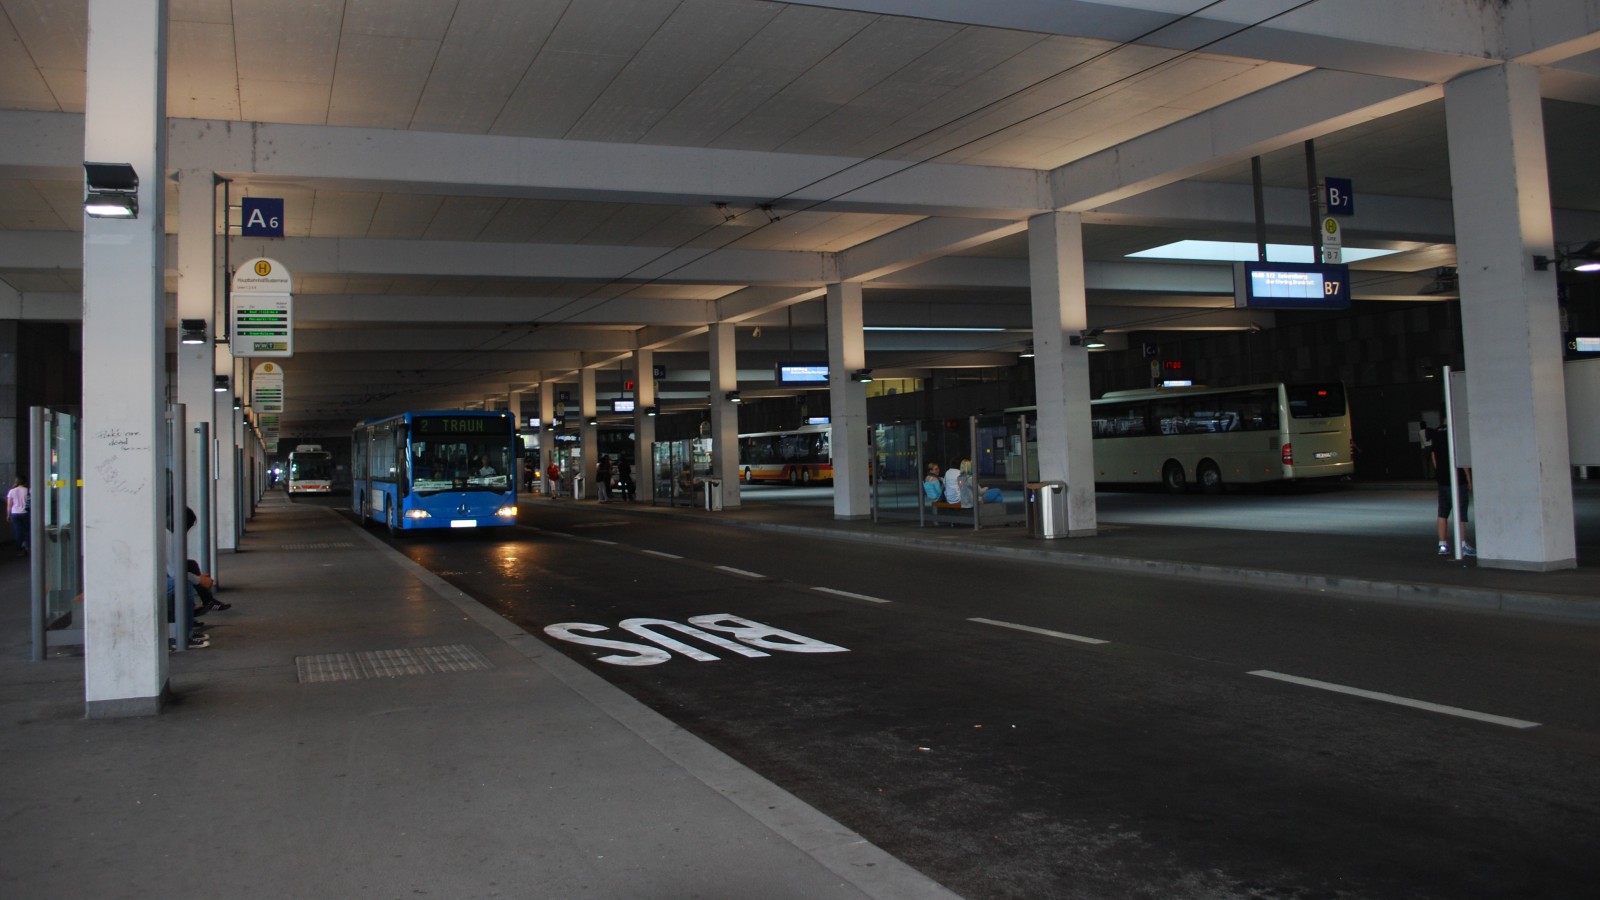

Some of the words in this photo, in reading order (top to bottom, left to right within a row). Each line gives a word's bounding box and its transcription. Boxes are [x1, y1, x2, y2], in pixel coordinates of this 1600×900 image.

[258, 263, 267, 273] H
[1324, 281, 1340, 295] B7
[420, 419, 428, 431] 2
[442, 419, 484, 431] TRAUN
[543, 613, 852, 666] BUS
